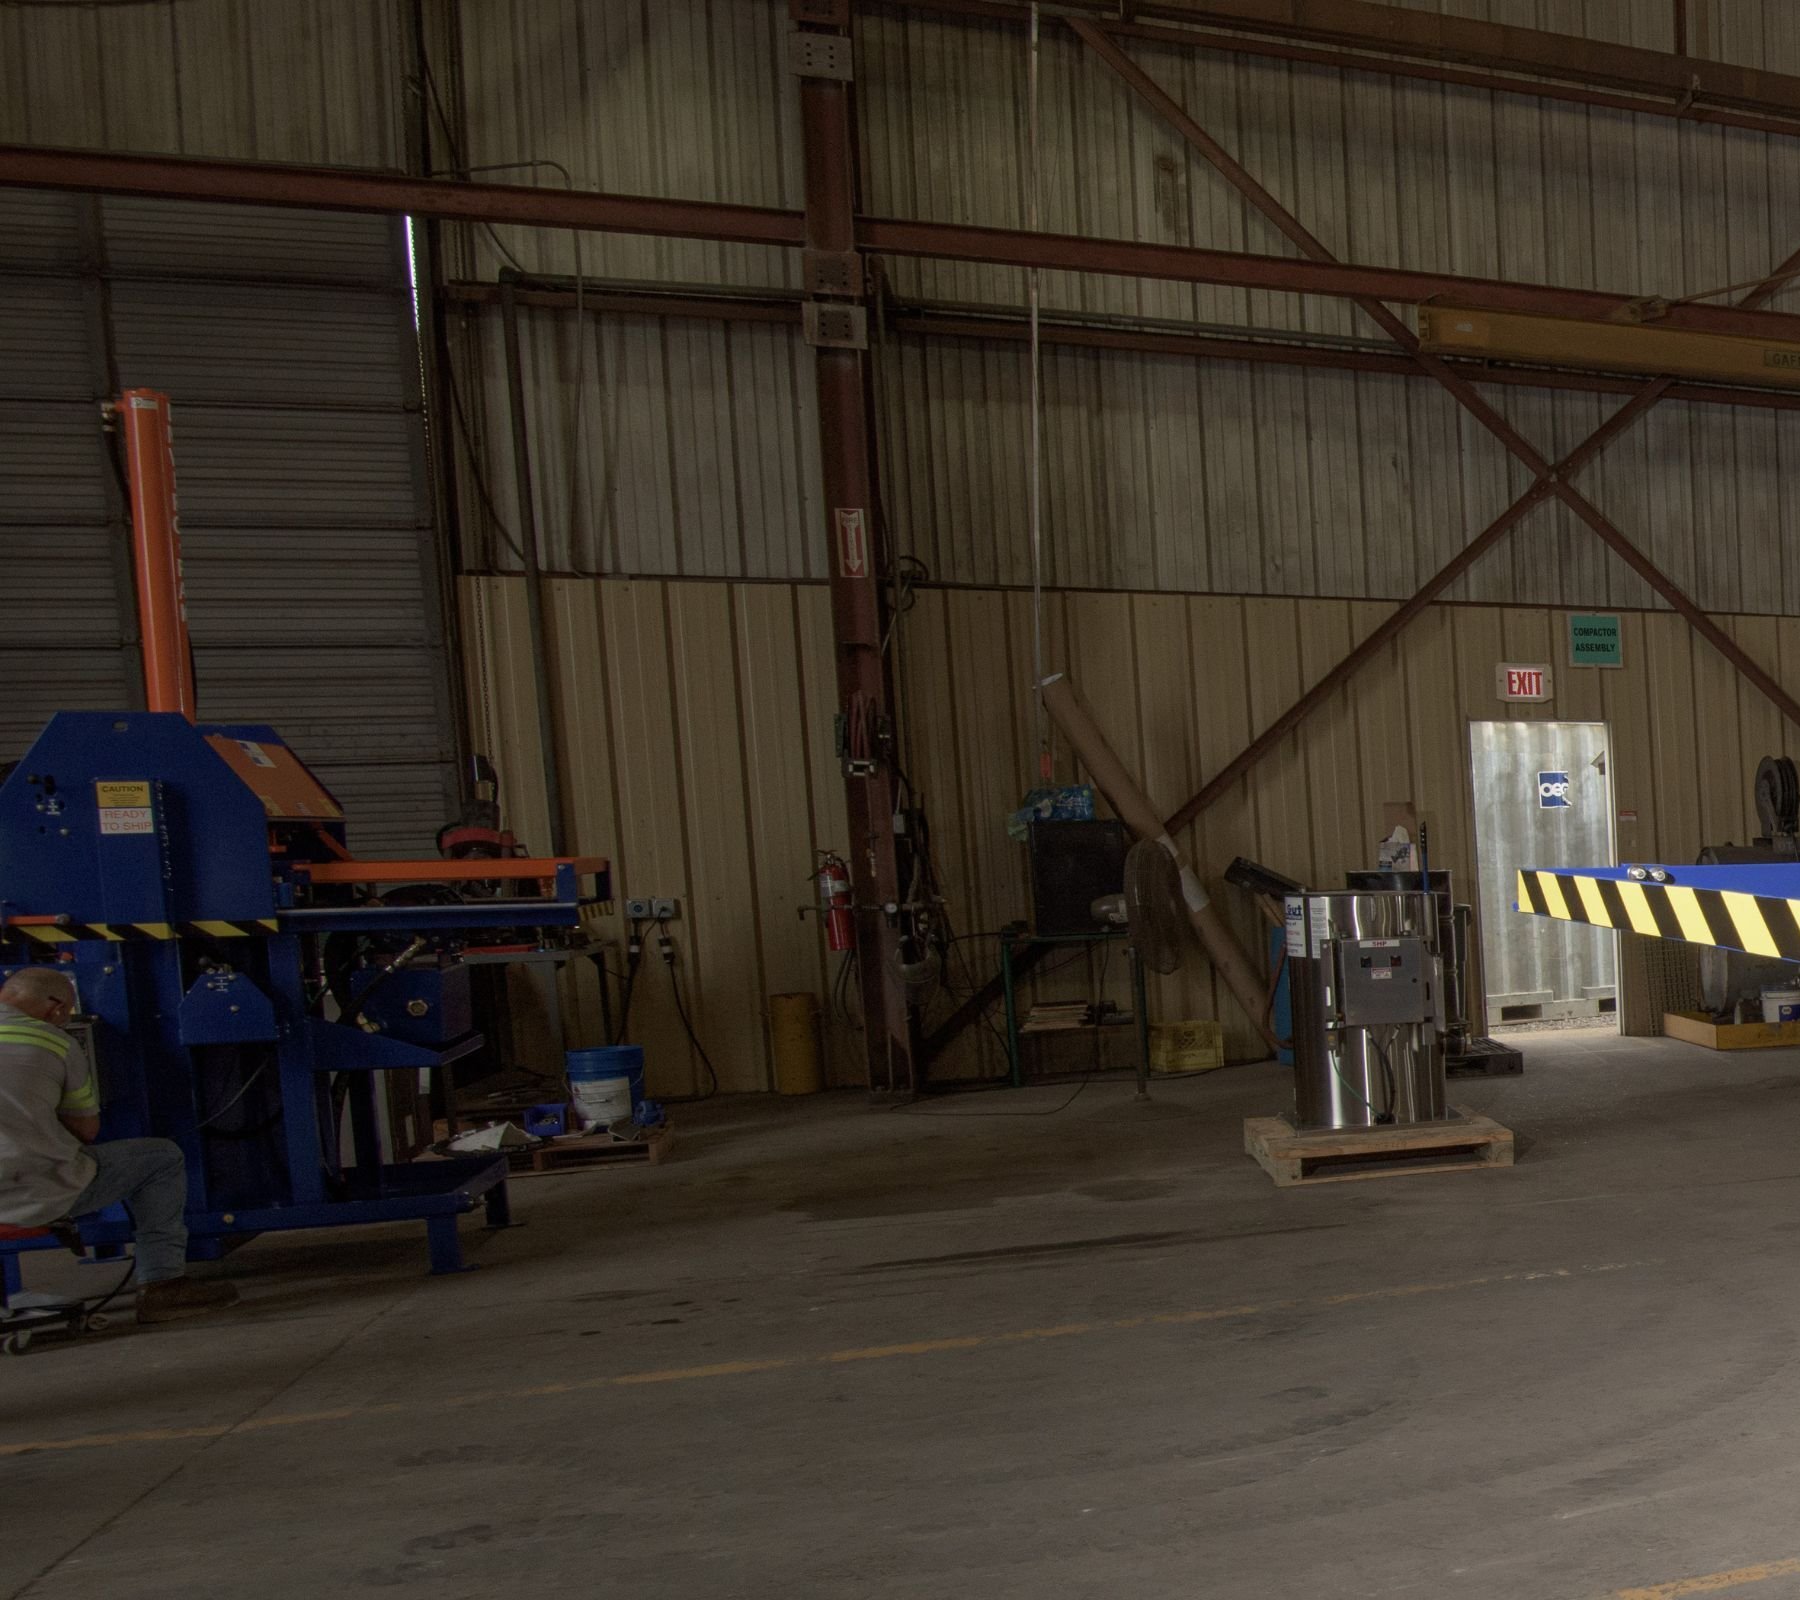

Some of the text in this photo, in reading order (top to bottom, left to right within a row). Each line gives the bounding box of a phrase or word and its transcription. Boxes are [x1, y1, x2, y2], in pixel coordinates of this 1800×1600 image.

[1573, 627, 1617, 637] COMPACTOR
[1575, 643, 1616, 652] ASSEMBLY
[1507, 671, 1543, 695] EXIT
[102, 785, 144, 793] CAUTION
[104, 810, 146, 818] READY
[102, 822, 152, 831] TO SHIP
